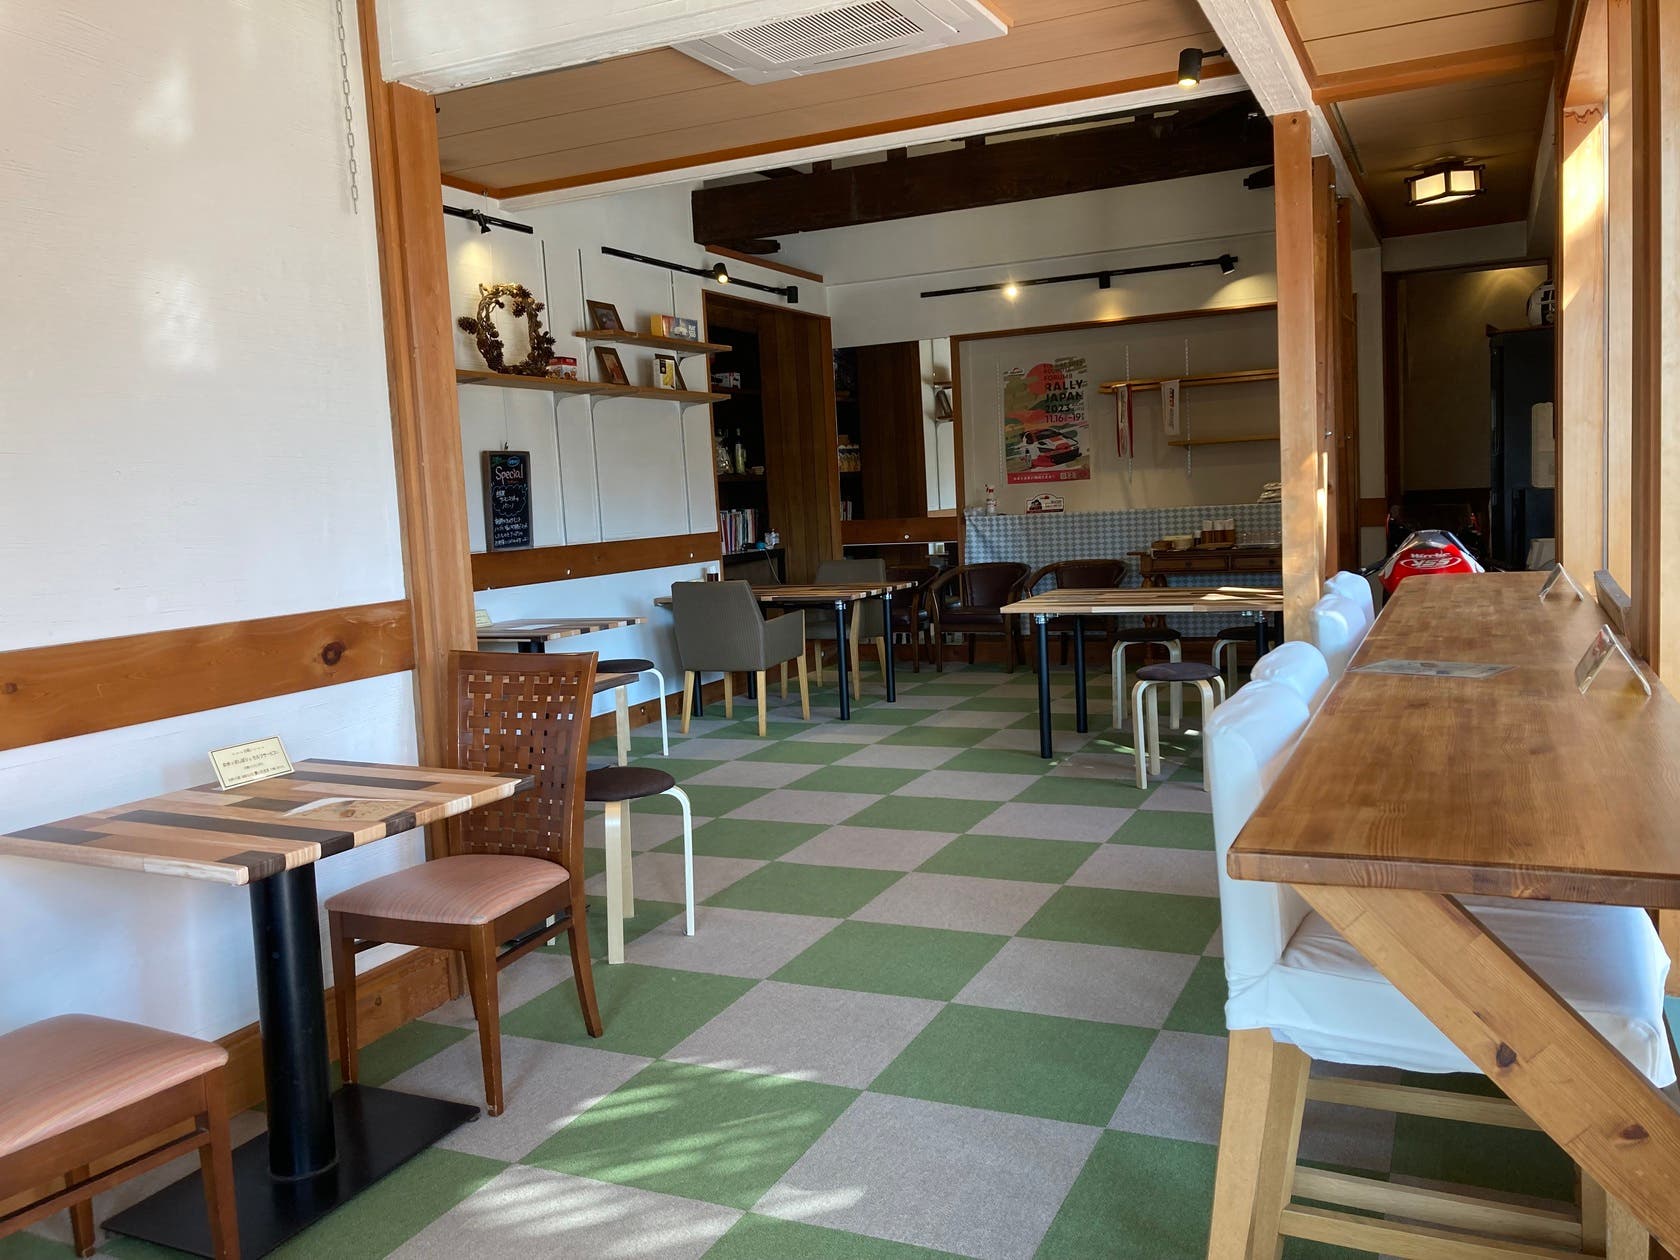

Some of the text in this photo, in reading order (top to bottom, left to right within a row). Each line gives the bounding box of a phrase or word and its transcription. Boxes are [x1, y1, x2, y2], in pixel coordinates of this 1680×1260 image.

[1045, 380, 1083, 391] RALLY
[1046, 391, 1083, 402] JAPAN
[495, 463, 524, 485] Special
